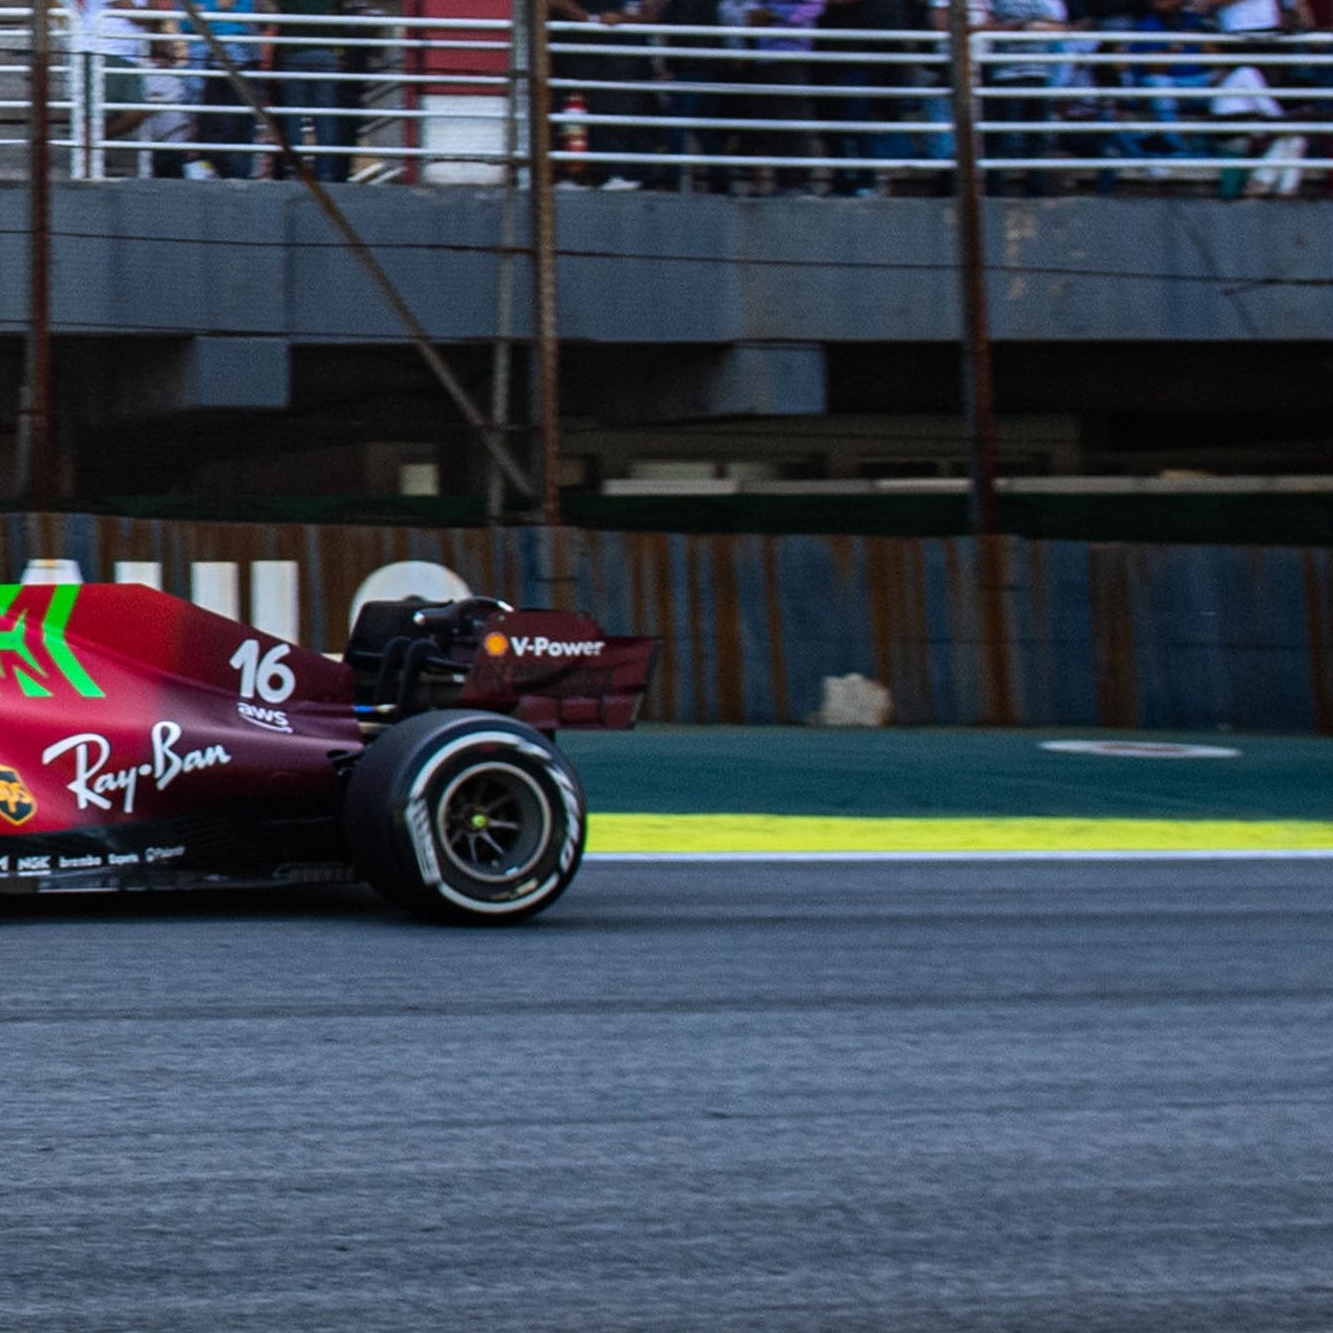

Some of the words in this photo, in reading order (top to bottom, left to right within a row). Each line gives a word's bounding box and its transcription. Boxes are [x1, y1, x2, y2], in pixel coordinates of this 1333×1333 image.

[510, 635, 605, 658] V-Power
[229, 639, 296, 704] 16
[237, 701, 290, 728] aws
[41, 720, 232, 814] Ray-Ban
